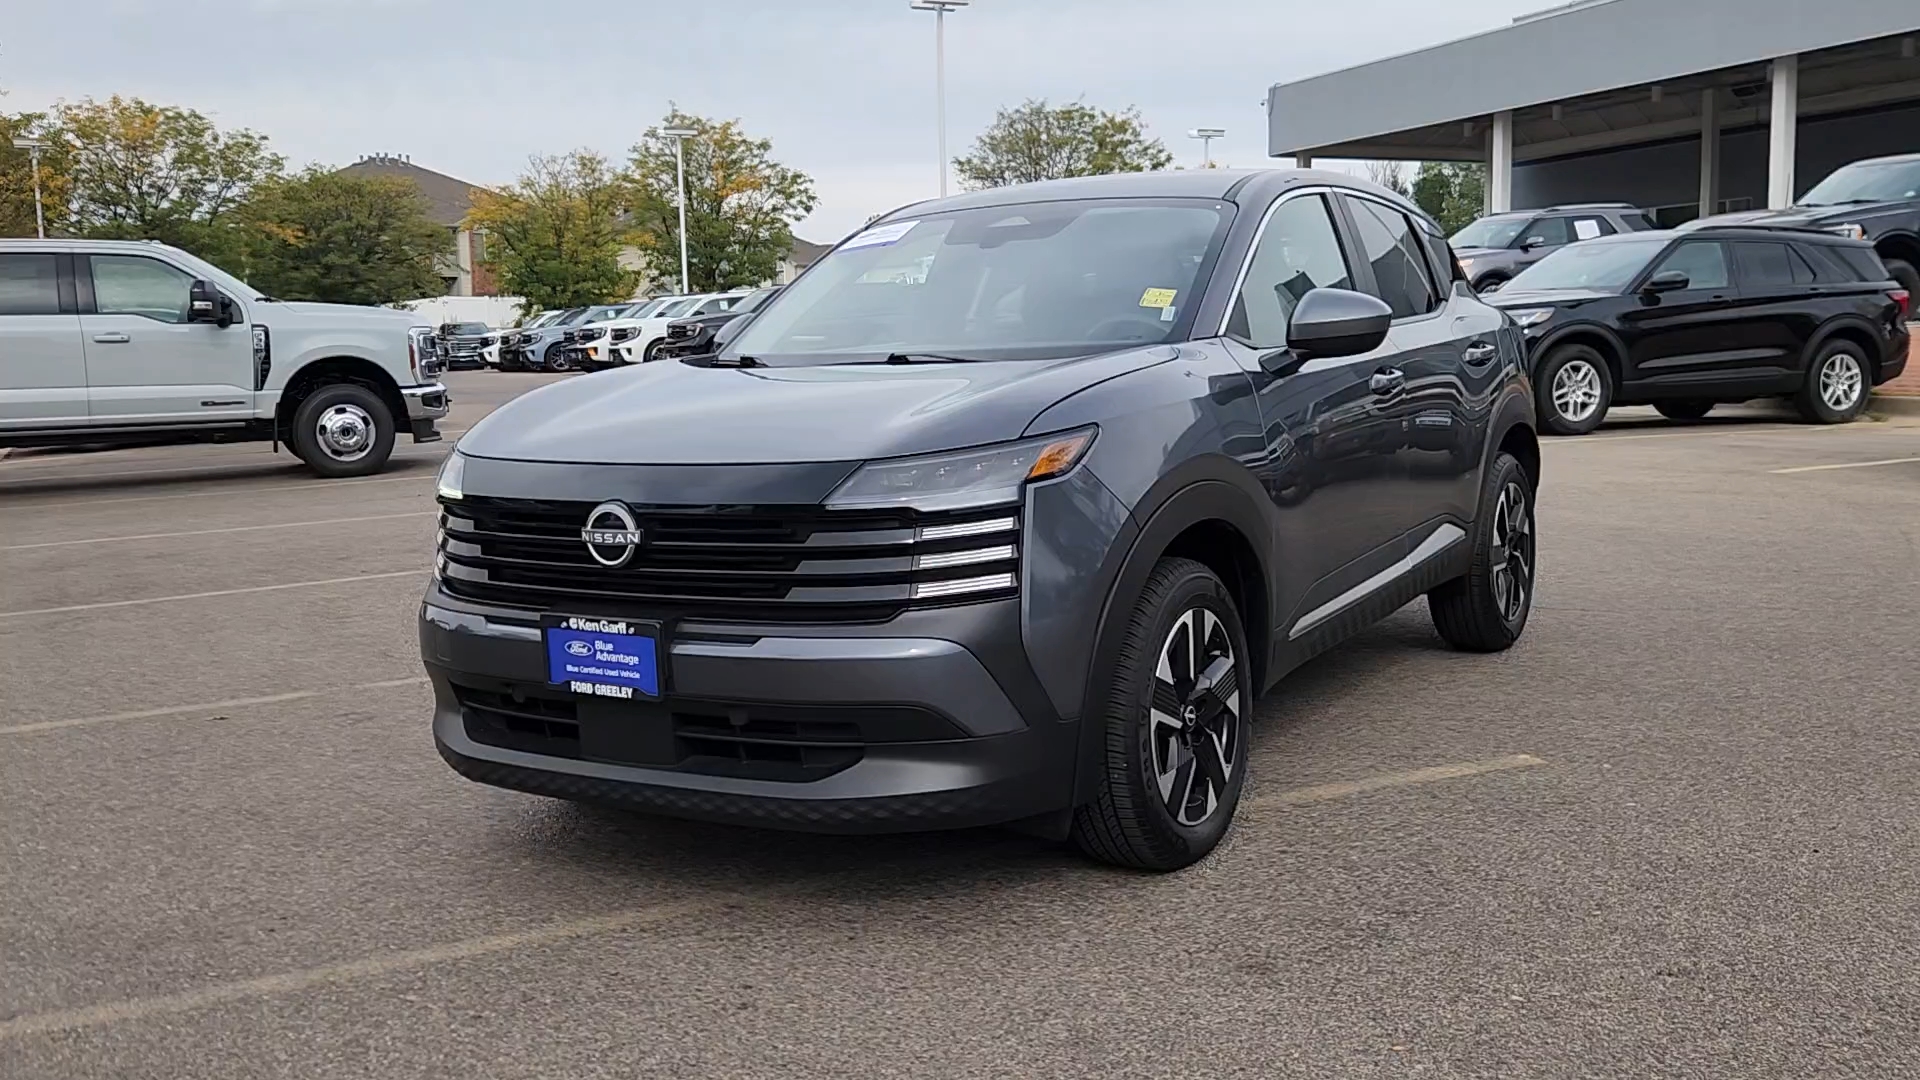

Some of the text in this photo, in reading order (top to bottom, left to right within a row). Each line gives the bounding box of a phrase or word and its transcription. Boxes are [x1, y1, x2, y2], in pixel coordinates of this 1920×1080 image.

[582, 531, 639, 544] NISSAN
[577, 618, 627, 634] Ken Garff
[570, 642, 589, 654] Ford
[594, 640, 614, 651] Blue
[595, 651, 640, 665] Advantage
[566, 664, 641, 679] Blue Certified Used Vehicle
[570, 681, 633, 699] FORD GREELEY
